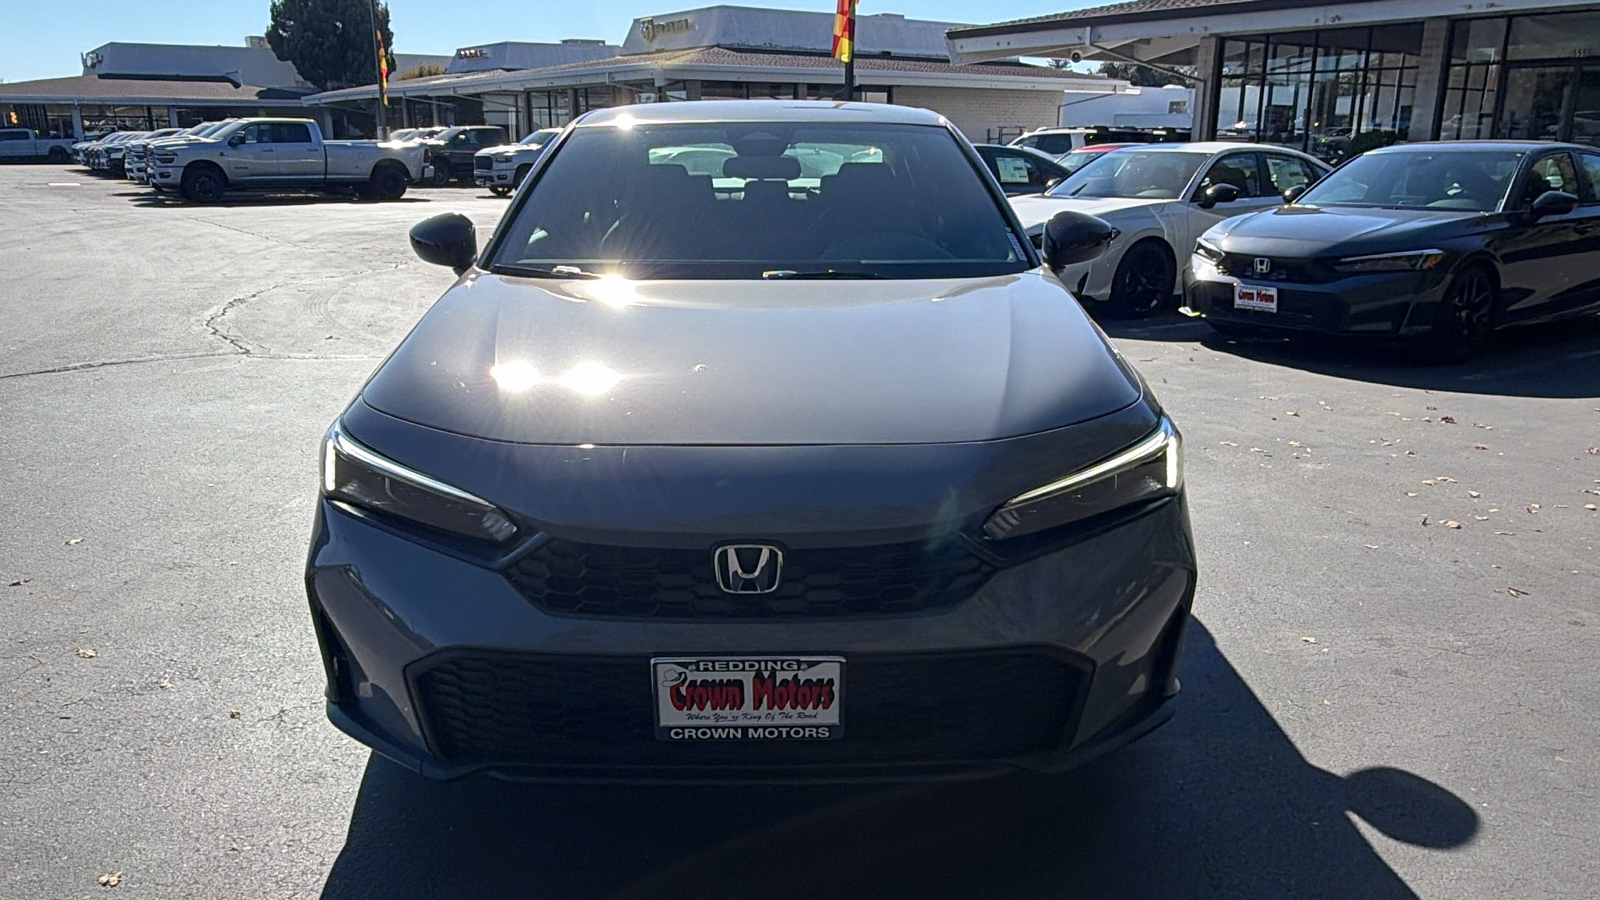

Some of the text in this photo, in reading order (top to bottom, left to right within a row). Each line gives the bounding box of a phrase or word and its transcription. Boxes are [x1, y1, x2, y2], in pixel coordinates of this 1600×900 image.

[699, 661, 798, 671] REDDING
[669, 670, 835, 712] Crown Motors
[741, 712, 762, 721] King
[765, 712, 777, 721] Of
[779, 712, 793, 720] The
[796, 711, 818, 720] Road
[670, 727, 830, 739] CROWN MOTORS
